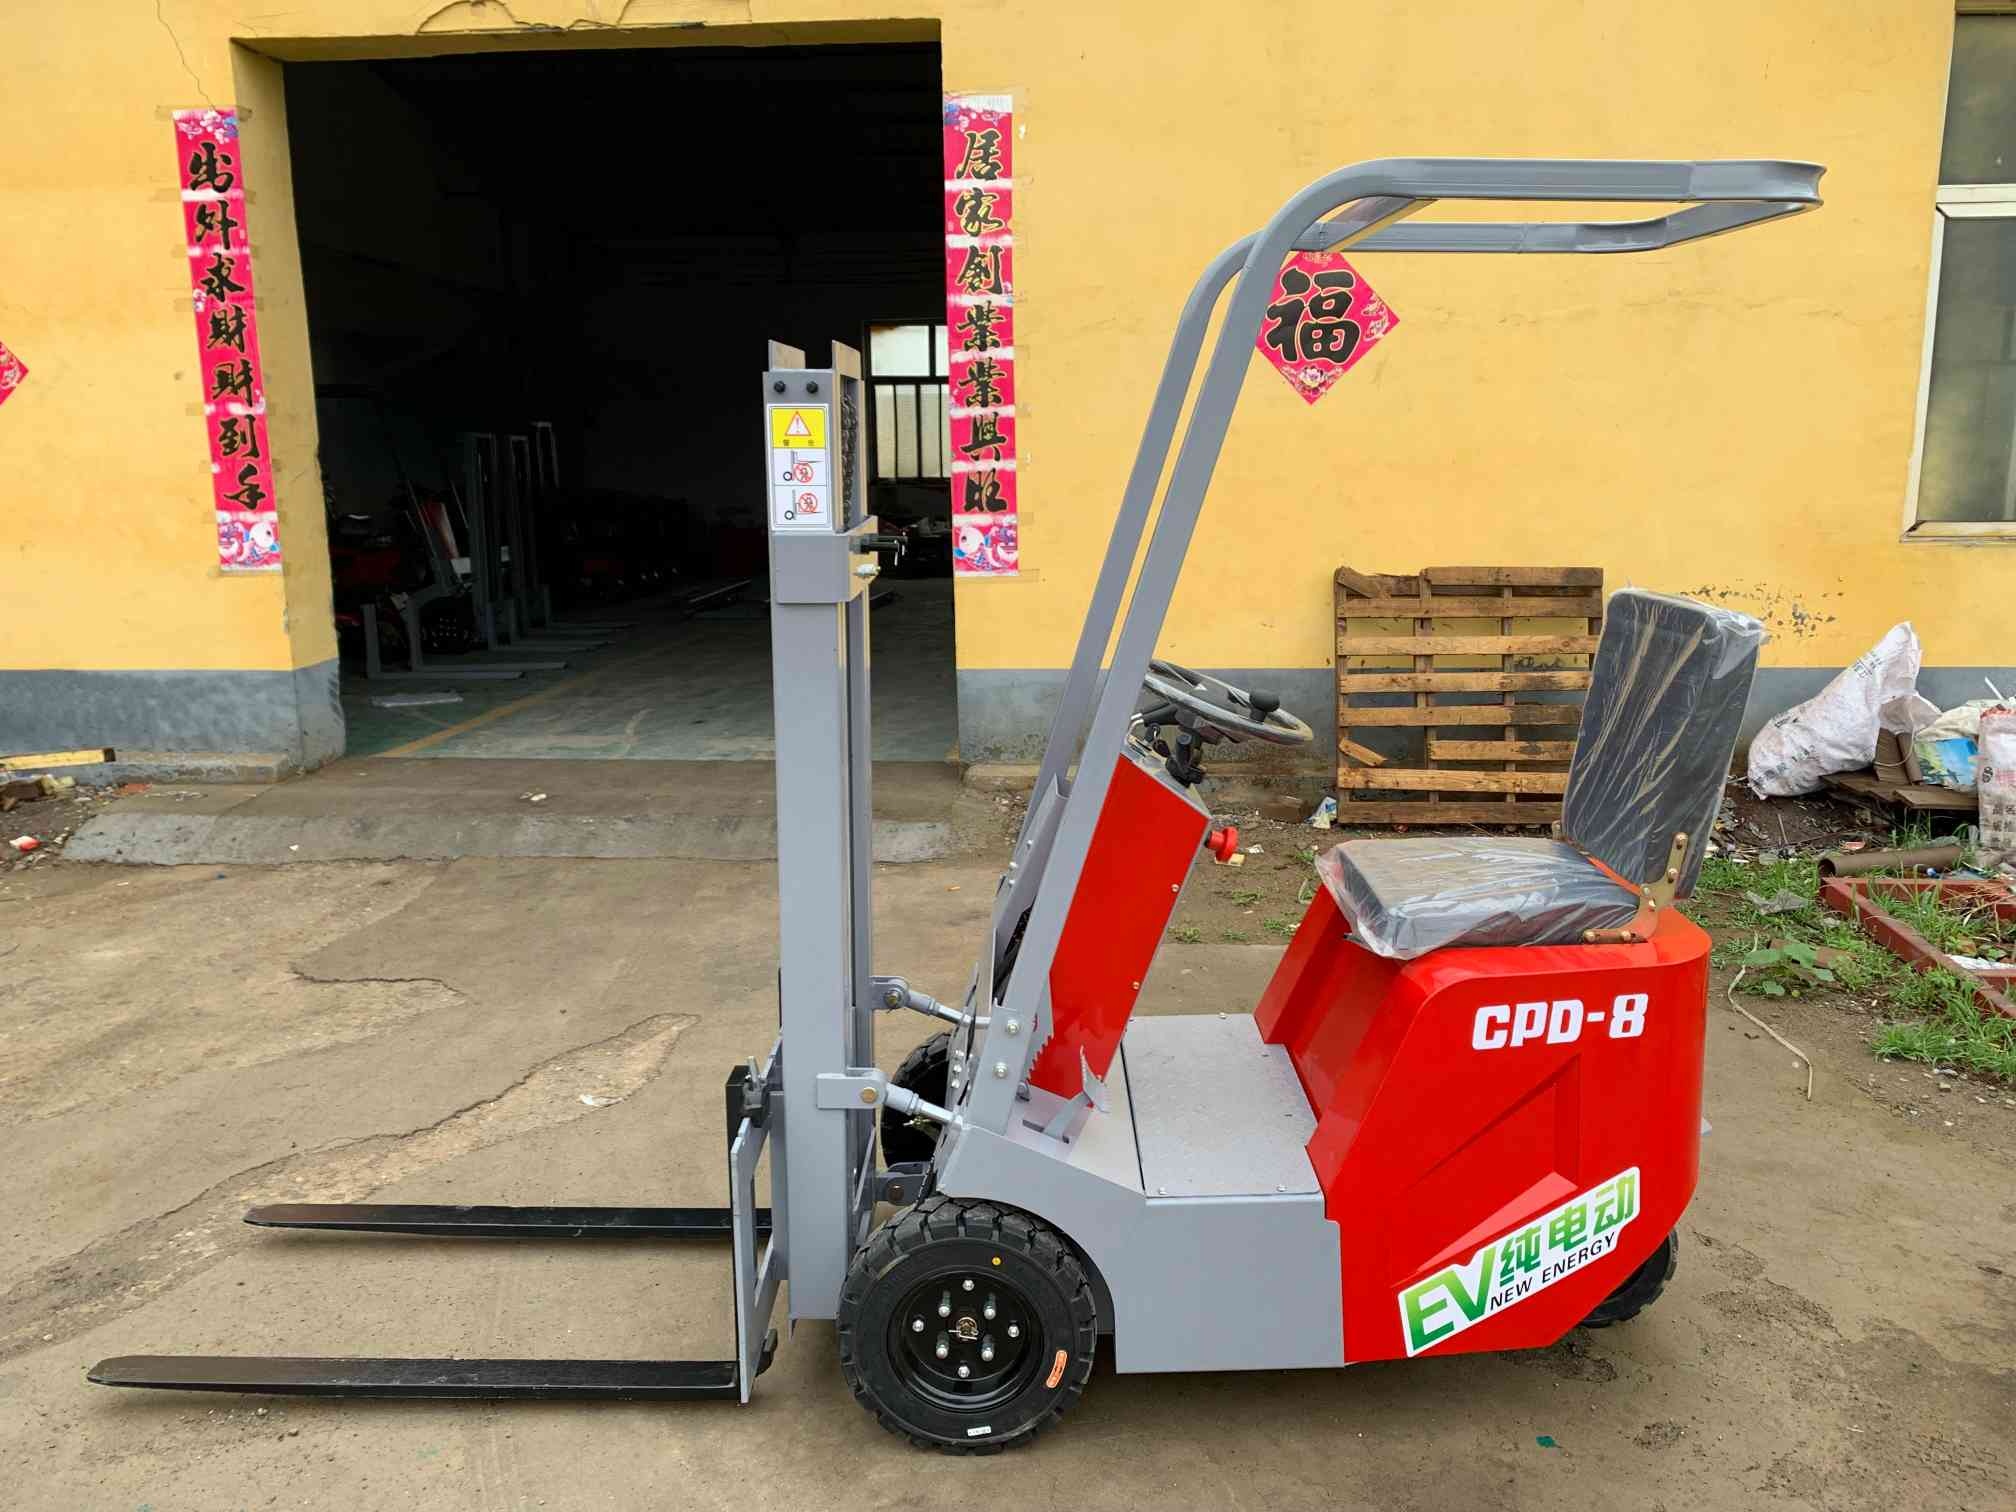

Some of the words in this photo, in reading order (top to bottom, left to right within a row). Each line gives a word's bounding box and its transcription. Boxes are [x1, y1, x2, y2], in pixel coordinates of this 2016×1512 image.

[1265, 267, 1361, 365] 福
[1471, 993, 1649, 1051] CPD-8
[1403, 1246, 1497, 1351] EV
[1500, 1174, 1636, 1287] 纯电动
[1490, 1277, 1532, 1310] NEW
[1542, 1232, 1615, 1283] ENERGY
